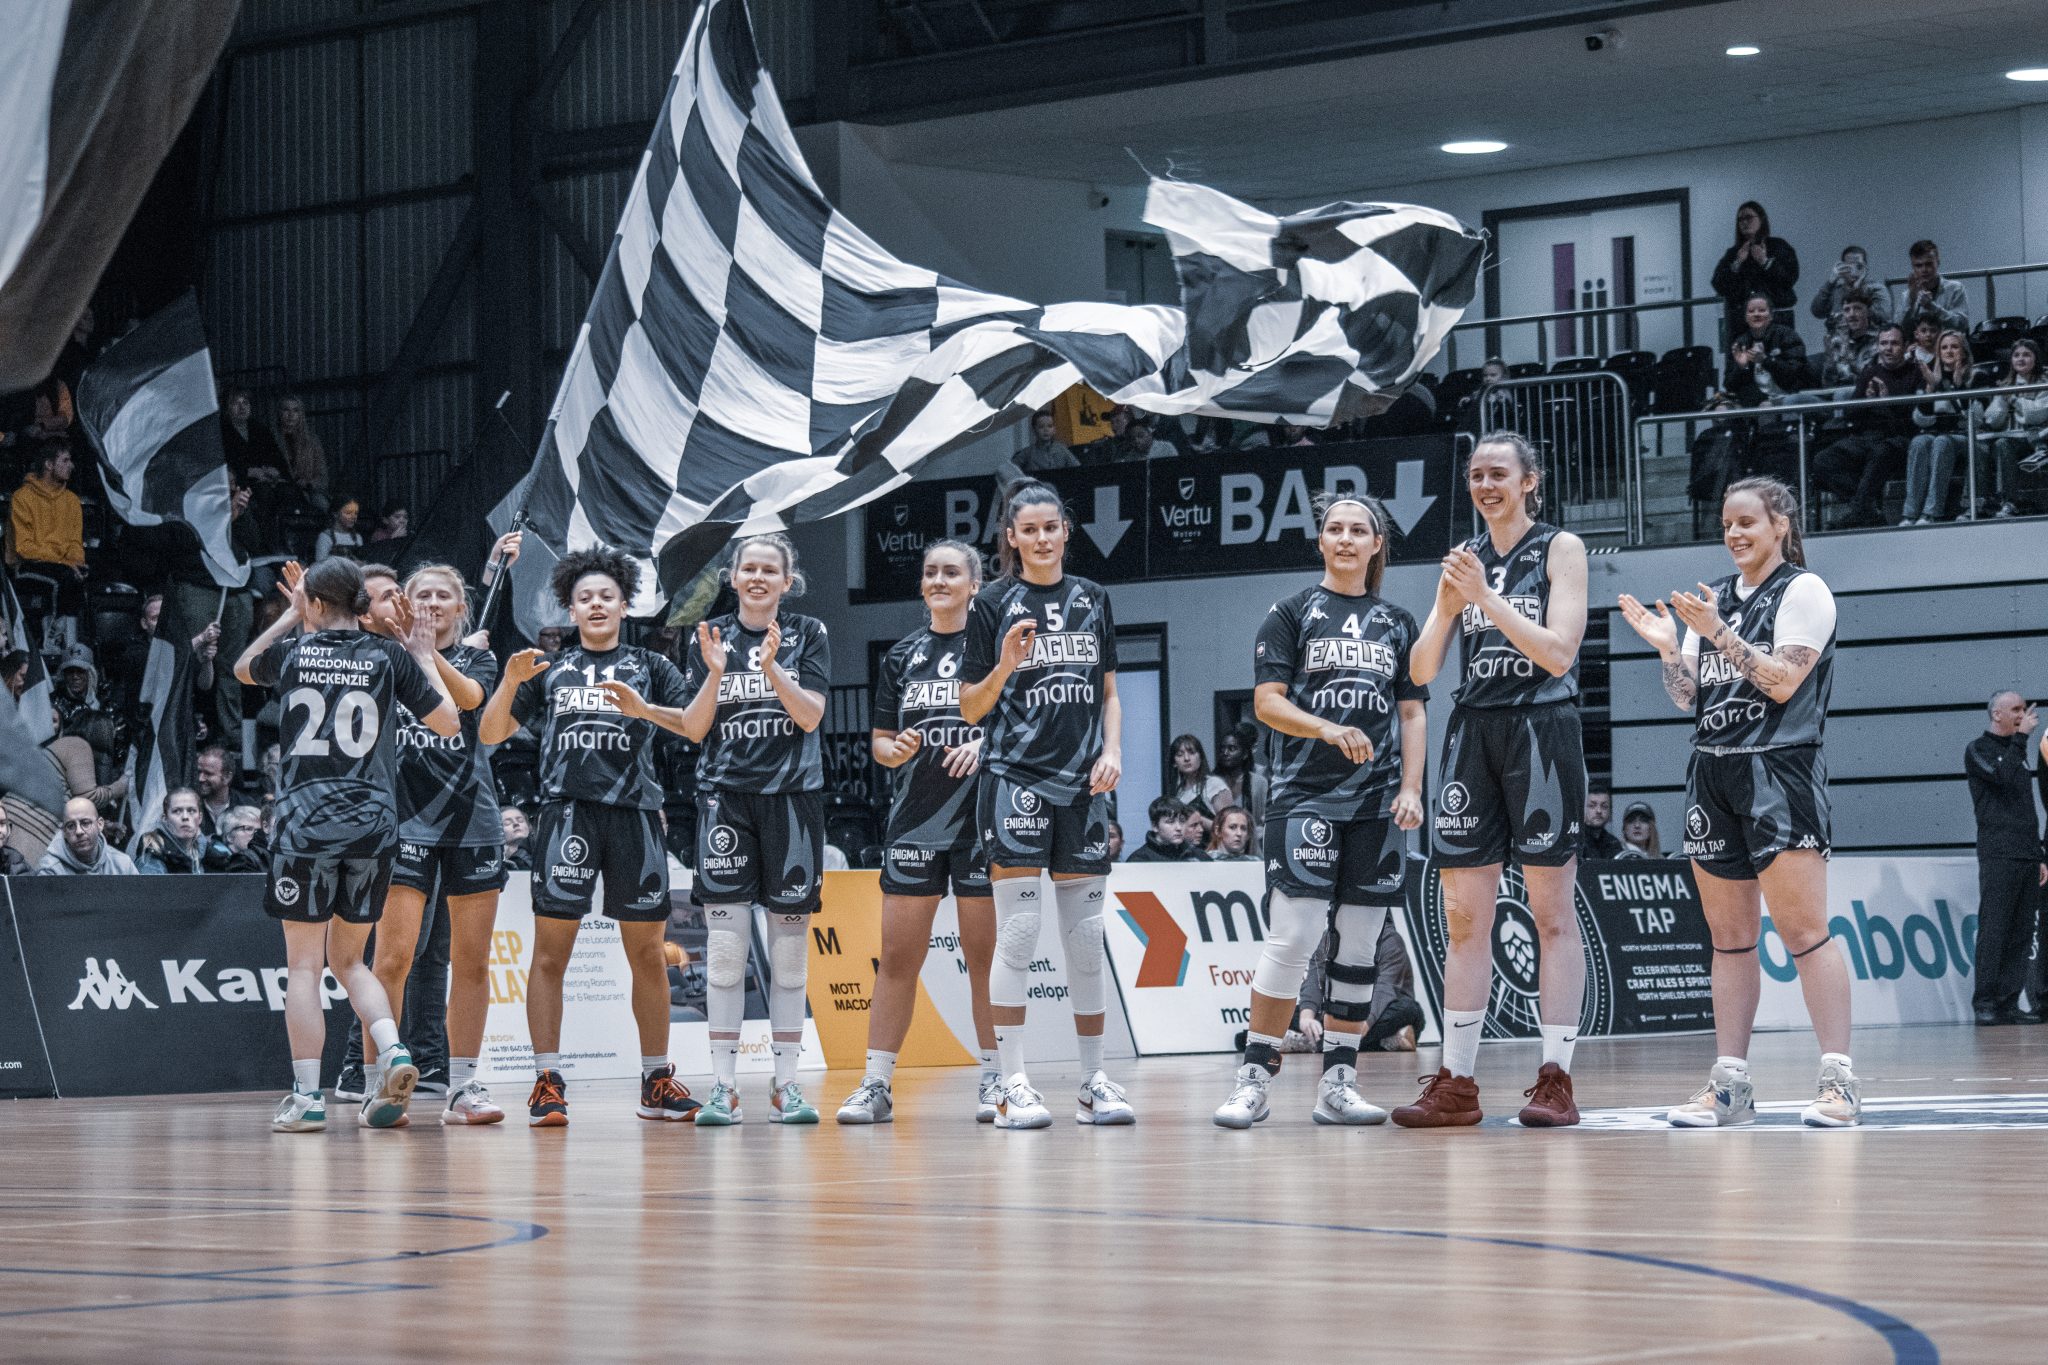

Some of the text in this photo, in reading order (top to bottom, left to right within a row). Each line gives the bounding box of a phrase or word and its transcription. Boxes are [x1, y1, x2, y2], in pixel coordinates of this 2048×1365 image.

[1160, 504, 1212, 528] Vertu
[877, 530, 924, 553] Vertu
[1490, 566, 1507, 595] 3
[1044, 602, 1064, 631] 5
[1341, 613, 1362, 639] 4
[300, 645, 334, 657] MOTT
[748, 646, 763, 671] 8
[1306, 639, 1394, 678] EAGLES
[298, 657, 374, 671] MACDONALD
[937, 652, 957, 678] 6
[298, 671, 370, 687] MACKENZIE
[582, 664, 615, 687] 11
[554, 687, 624, 716] EAGL
[902, 680, 961, 712] EAGL
[1025, 683, 1094, 708] marra
[1312, 688, 1389, 714] marra
[289, 687, 379, 758] 20
[721, 717, 794, 740] marra
[558, 731, 631, 752] marra
[1004, 818, 1049, 829] ENIGMA TAP
[1435, 816, 1479, 829] ENIGMA TAP
[890, 848, 936, 860] ENIGMA TAP
[1293, 848, 1339, 861] ENIGMA TAP
[1707, 839, 1726, 853] TAP
[551, 865, 595, 880] ENIGMA TAP
[703, 856, 748, 870] ENIGMA TAP
[1598, 874, 1691, 900] ENIGMA
[594, 920, 615, 931] Stay
[1628, 908, 1676, 934] TAP
[571, 950, 606, 958] edrooms
[1632, 964, 1706, 976] CELEBRATING LOCAL
[161, 958, 349, 1011] Kapp
[829, 983, 861, 995] MOTT
[1626, 979, 1655, 989] CRAFT
[1656, 978, 1677, 988] ALES
[1685, 976, 1712, 986] SPIRIT
[834, 998, 872, 1011] MACD
[1637, 990, 1712, 1001] NORTH SHIELDS HERITAG
